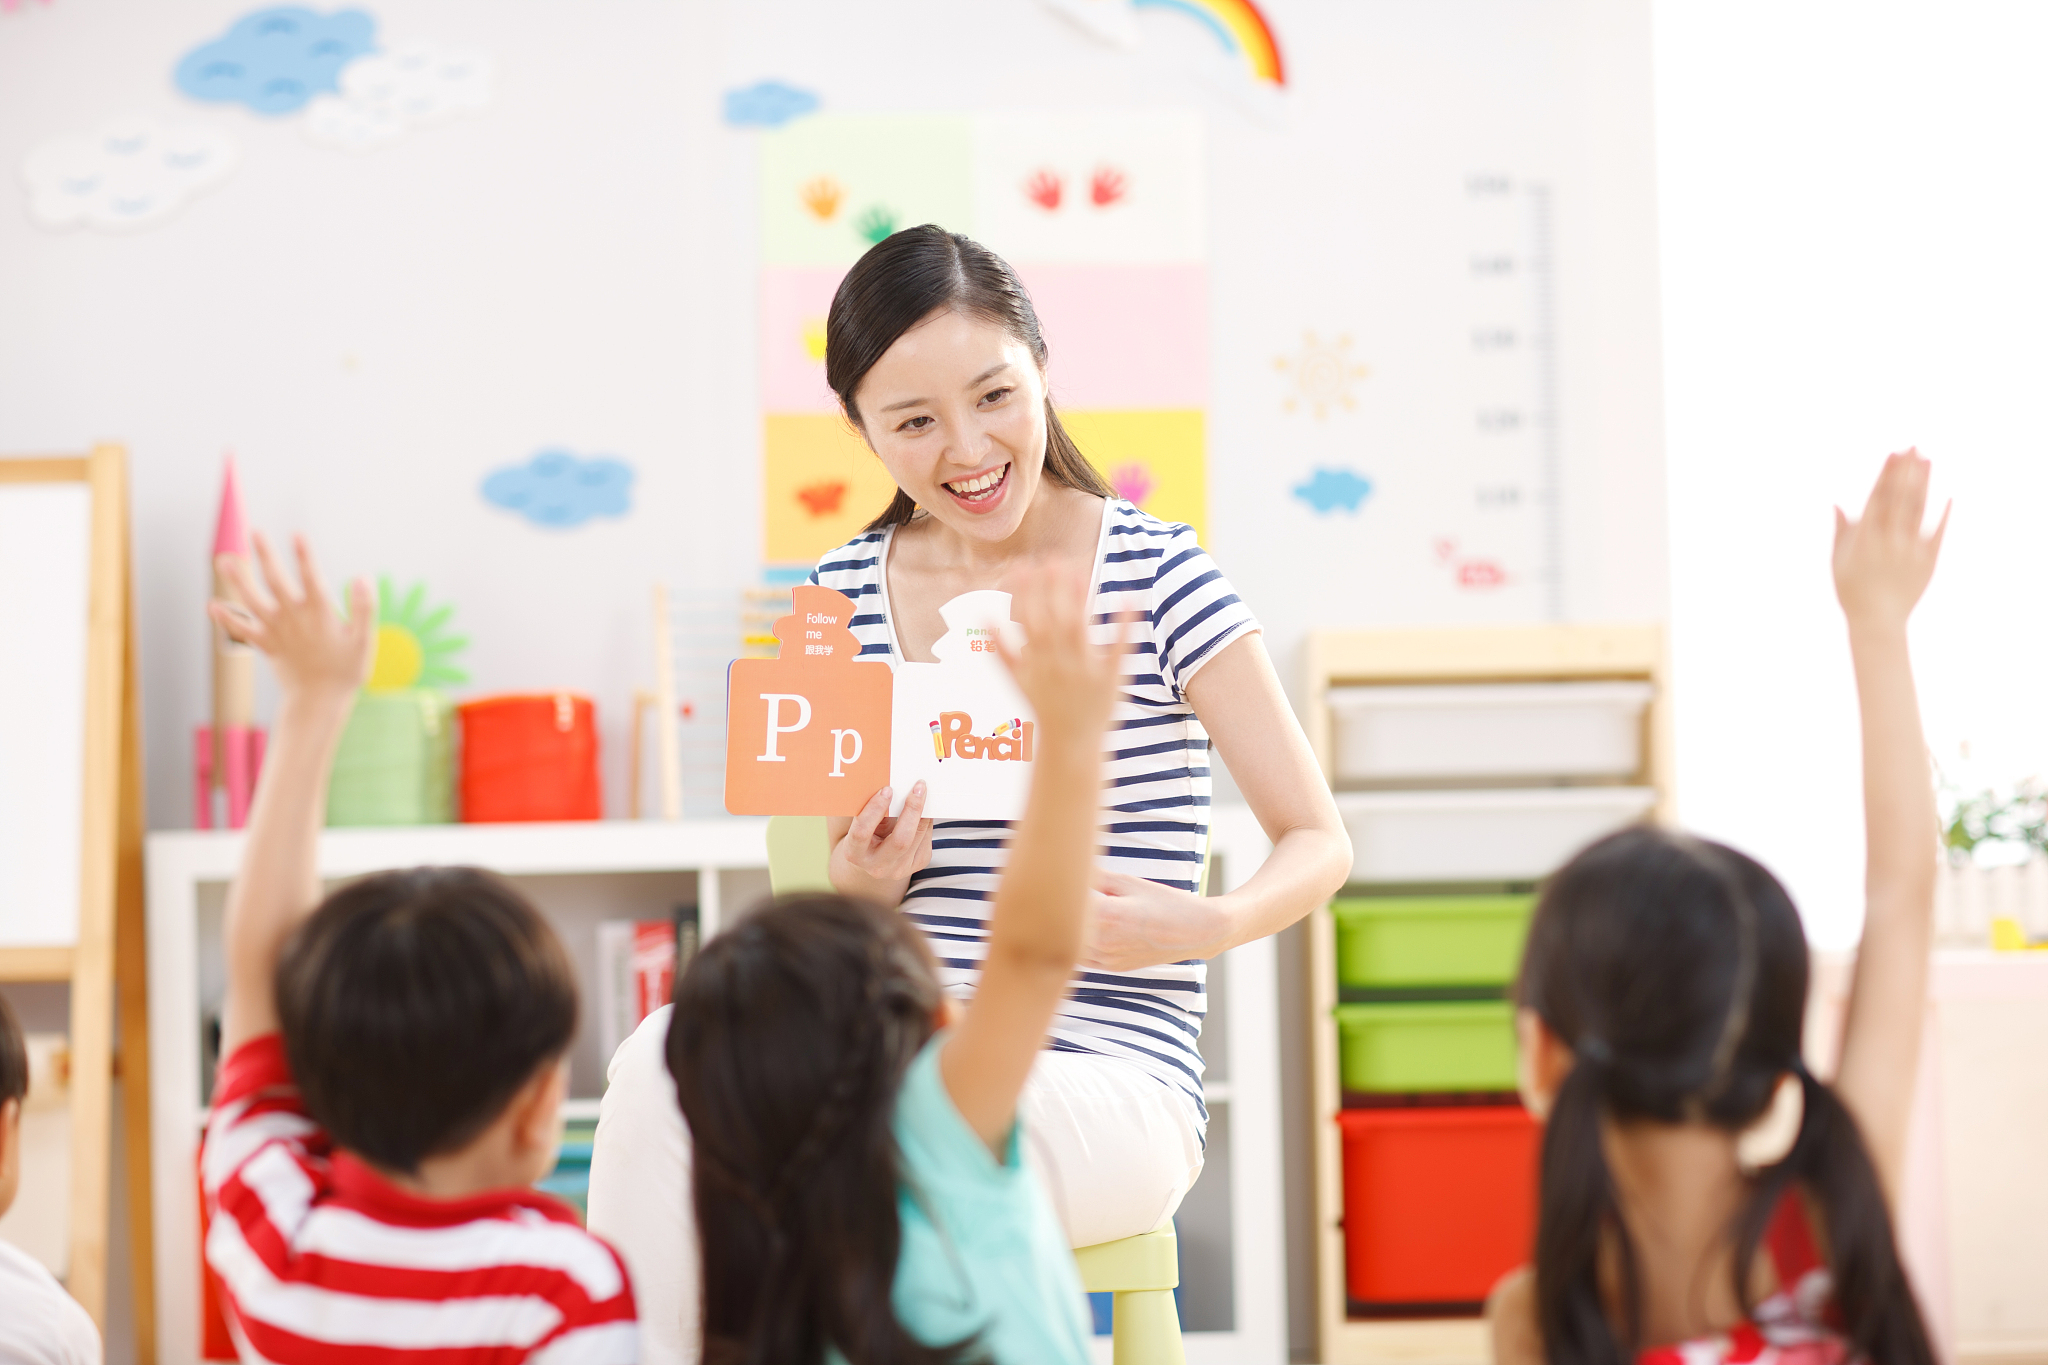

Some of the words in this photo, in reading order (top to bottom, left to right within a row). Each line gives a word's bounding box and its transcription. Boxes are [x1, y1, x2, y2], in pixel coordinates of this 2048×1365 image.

[806, 613, 838, 625] Follow
[806, 630, 823, 640] me
[805, 644, 834, 656] 跟我学
[970, 639, 997, 653] 铅笔
[756, 693, 812, 762] P
[828, 728, 863, 777] p
[939, 711, 1035, 762] Pencil
